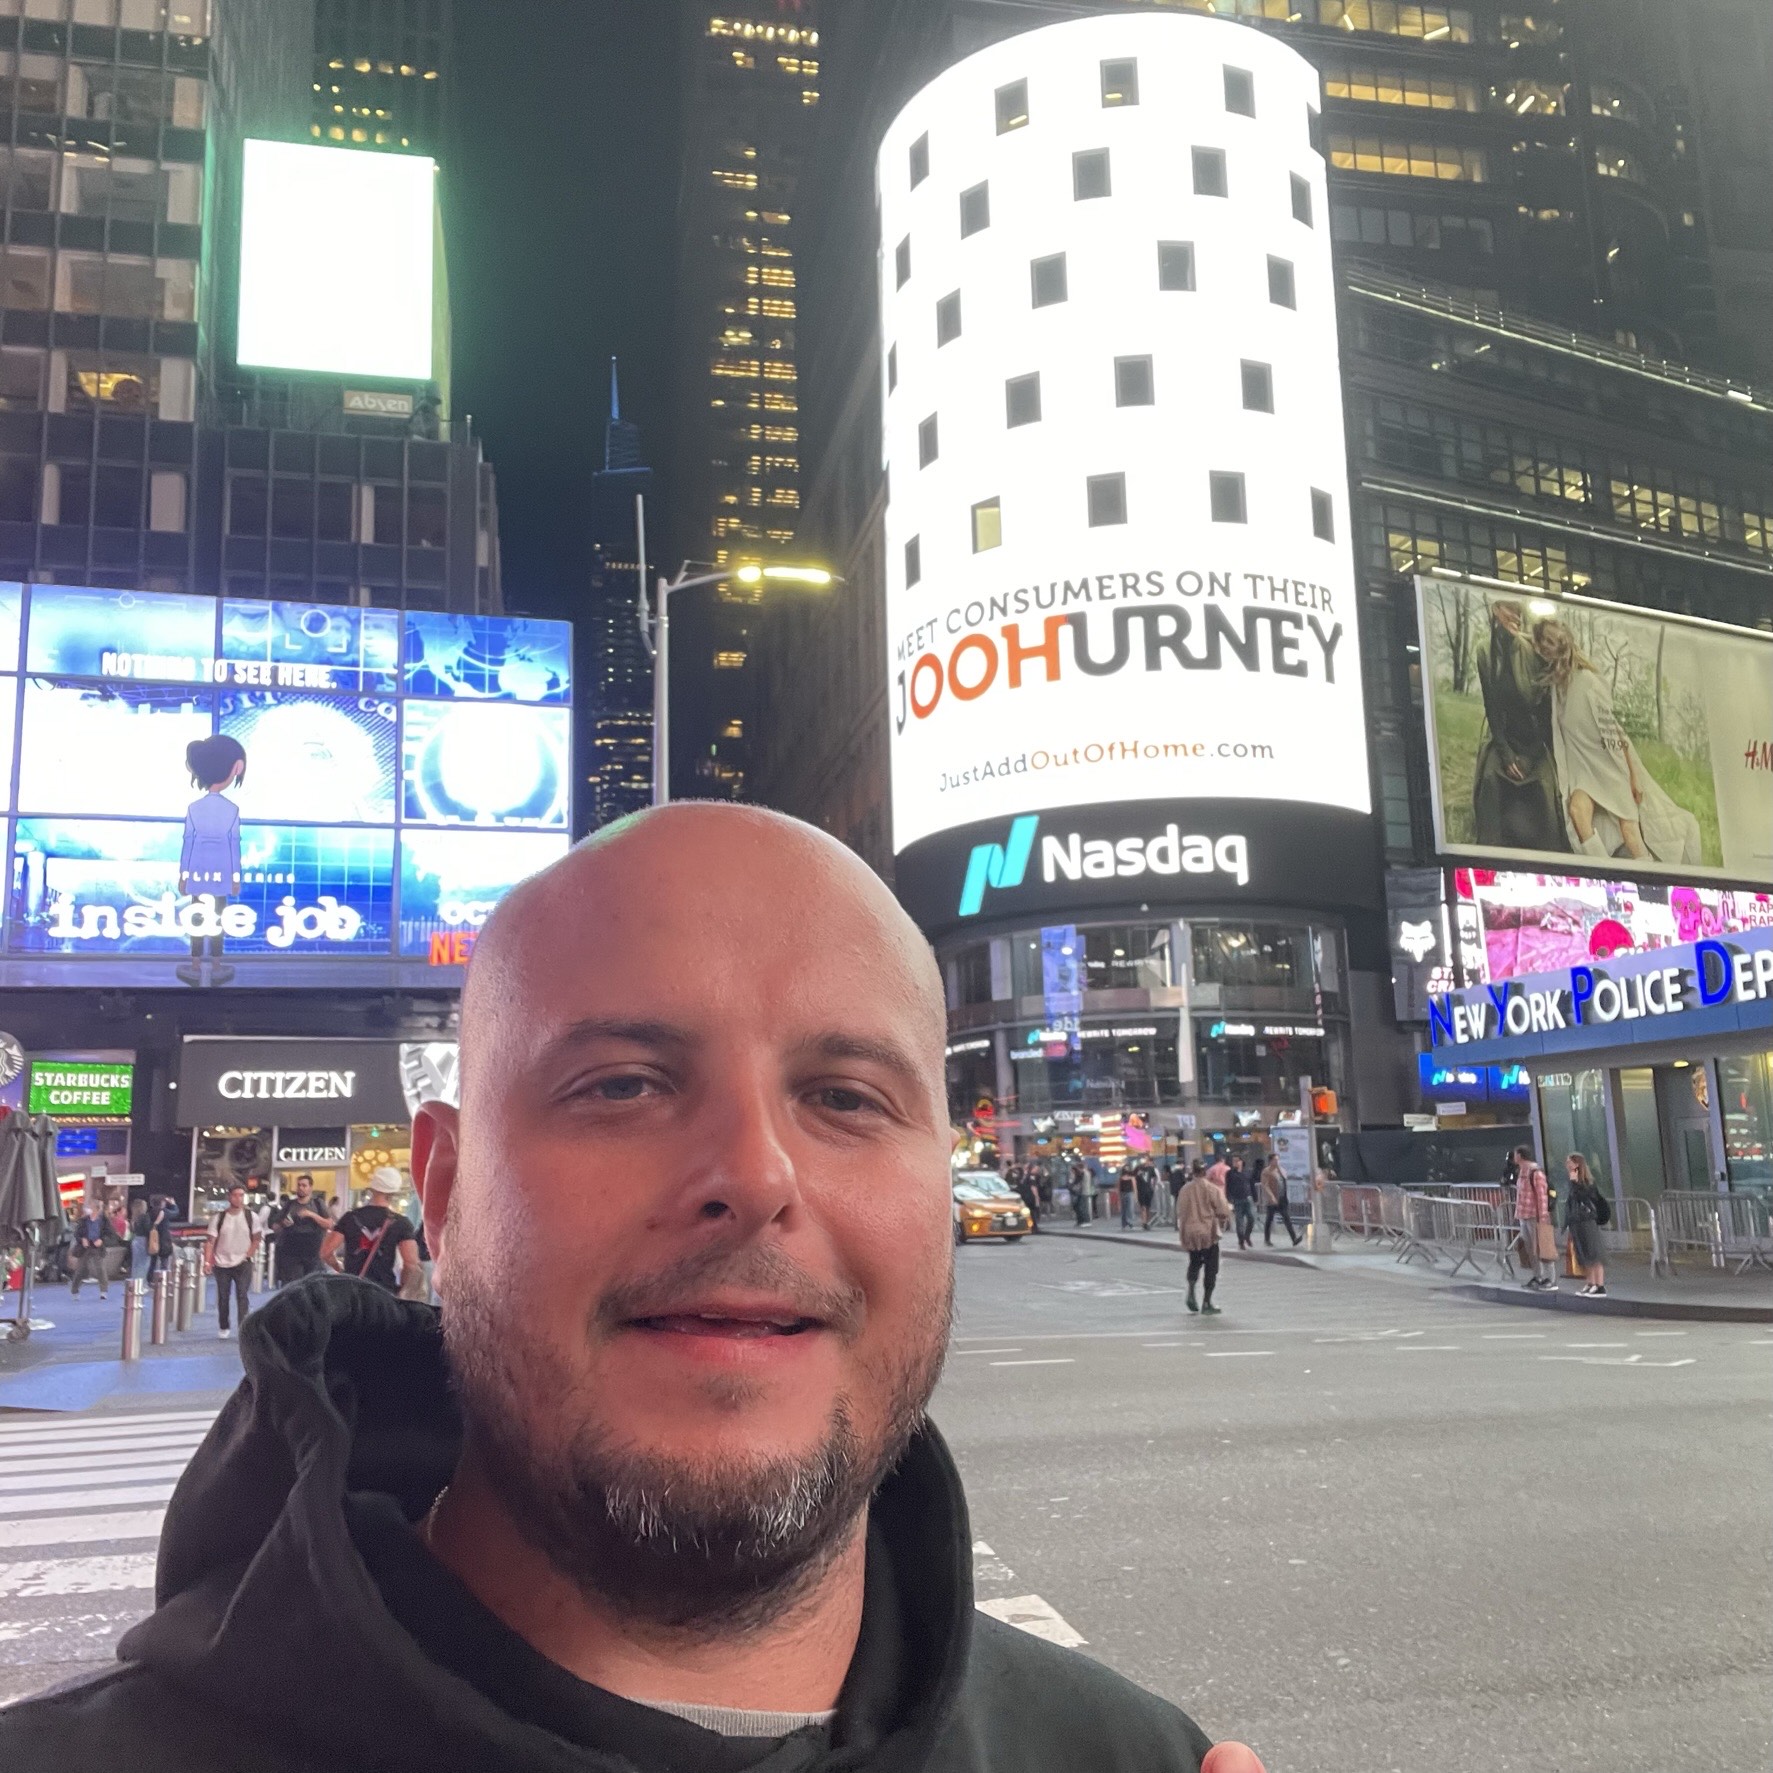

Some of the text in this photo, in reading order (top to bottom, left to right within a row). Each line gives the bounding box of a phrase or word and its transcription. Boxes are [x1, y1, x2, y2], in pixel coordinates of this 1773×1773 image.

[897, 570, 1334, 662] MEET CONSUMERS ON THEIR
[200, 656, 228, 683] TO
[896, 603, 1343, 736] JOOHURNEY
[939, 740, 1275, 792] JustAddOutOfHome.com
[1042, 823, 1249, 886] Nasdaq
[49, 892, 362, 947] inside job
[1428, 991, 1487, 1048] NEW
[1487, 981, 1567, 1037] YORK
[1570, 966, 1684, 1025] POLICE
[34, 1072, 131, 1088] STARBUCKS
[49, 1090, 111, 1105] COFFEE
[218, 1071, 356, 1099] CITIZEN
[279, 1148, 346, 1162] CITIZEN
